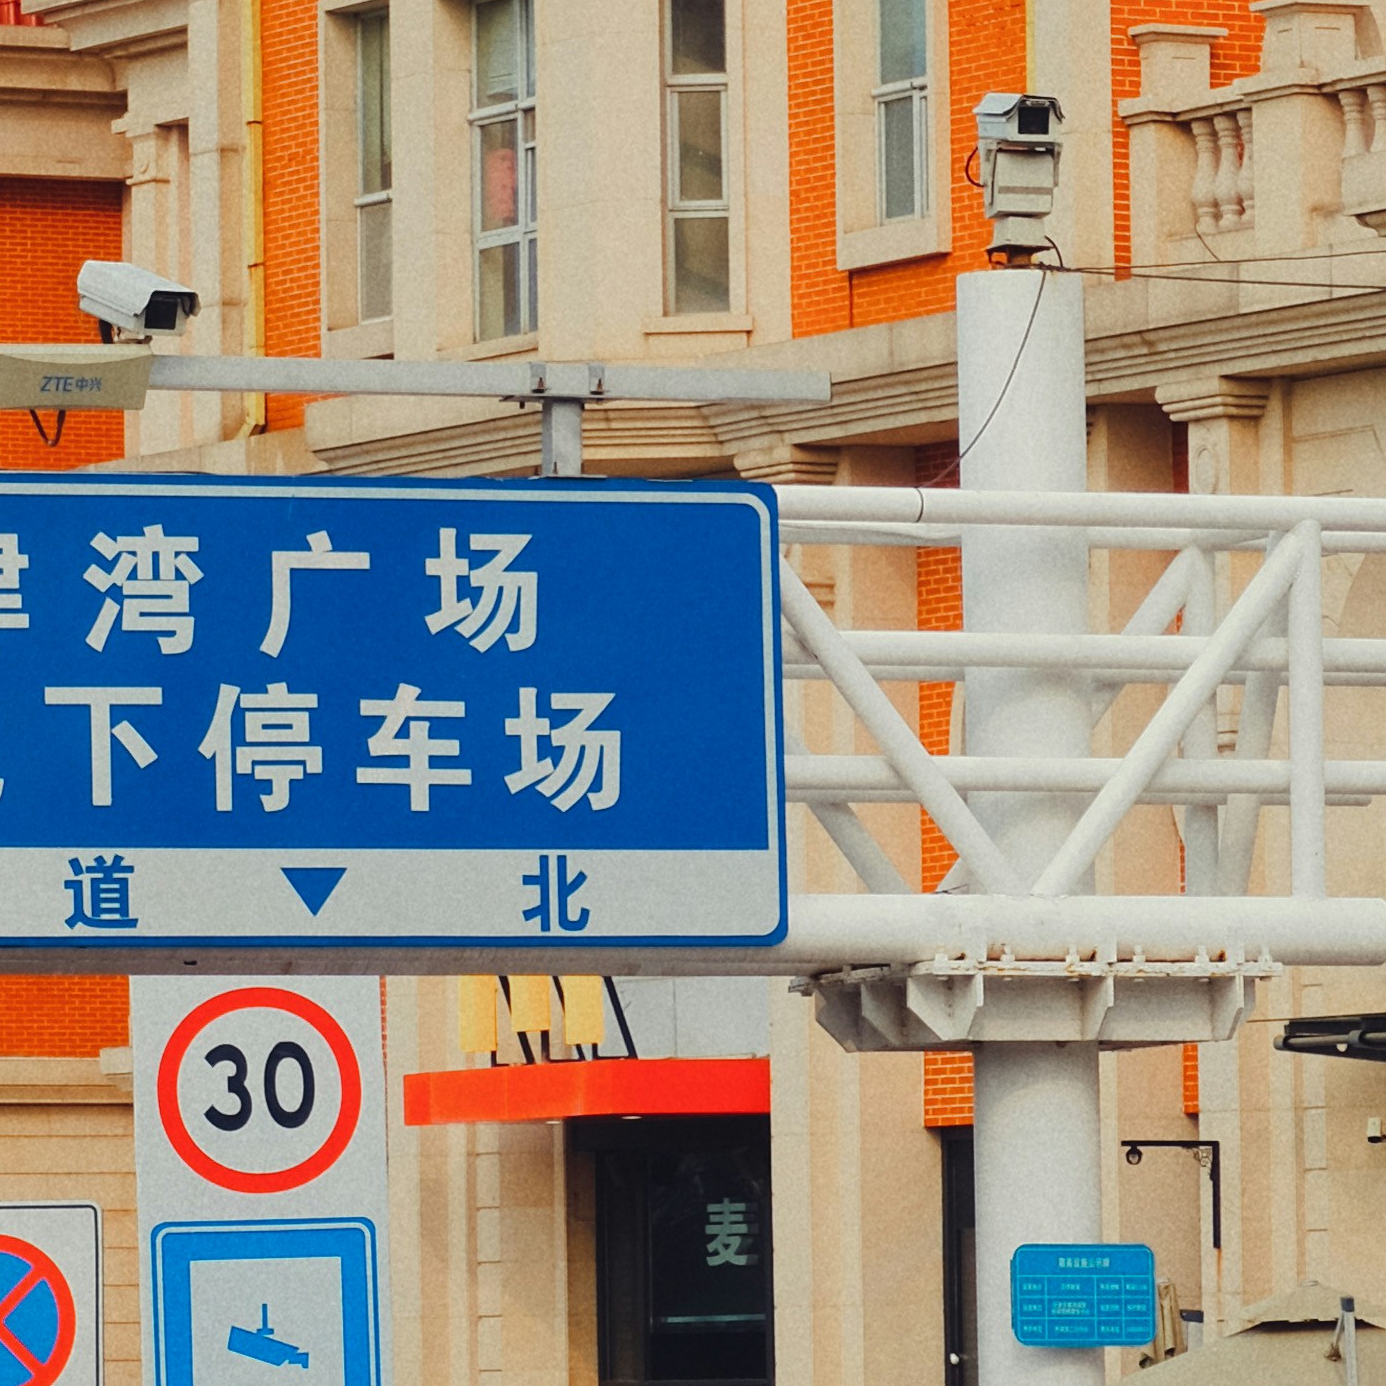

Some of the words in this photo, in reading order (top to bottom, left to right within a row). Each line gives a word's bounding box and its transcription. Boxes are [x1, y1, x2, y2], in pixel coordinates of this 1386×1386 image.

[522, 854, 590, 933] 北
[204, 1041, 315, 1132] 30
[705, 1198, 749, 1267] 麦
